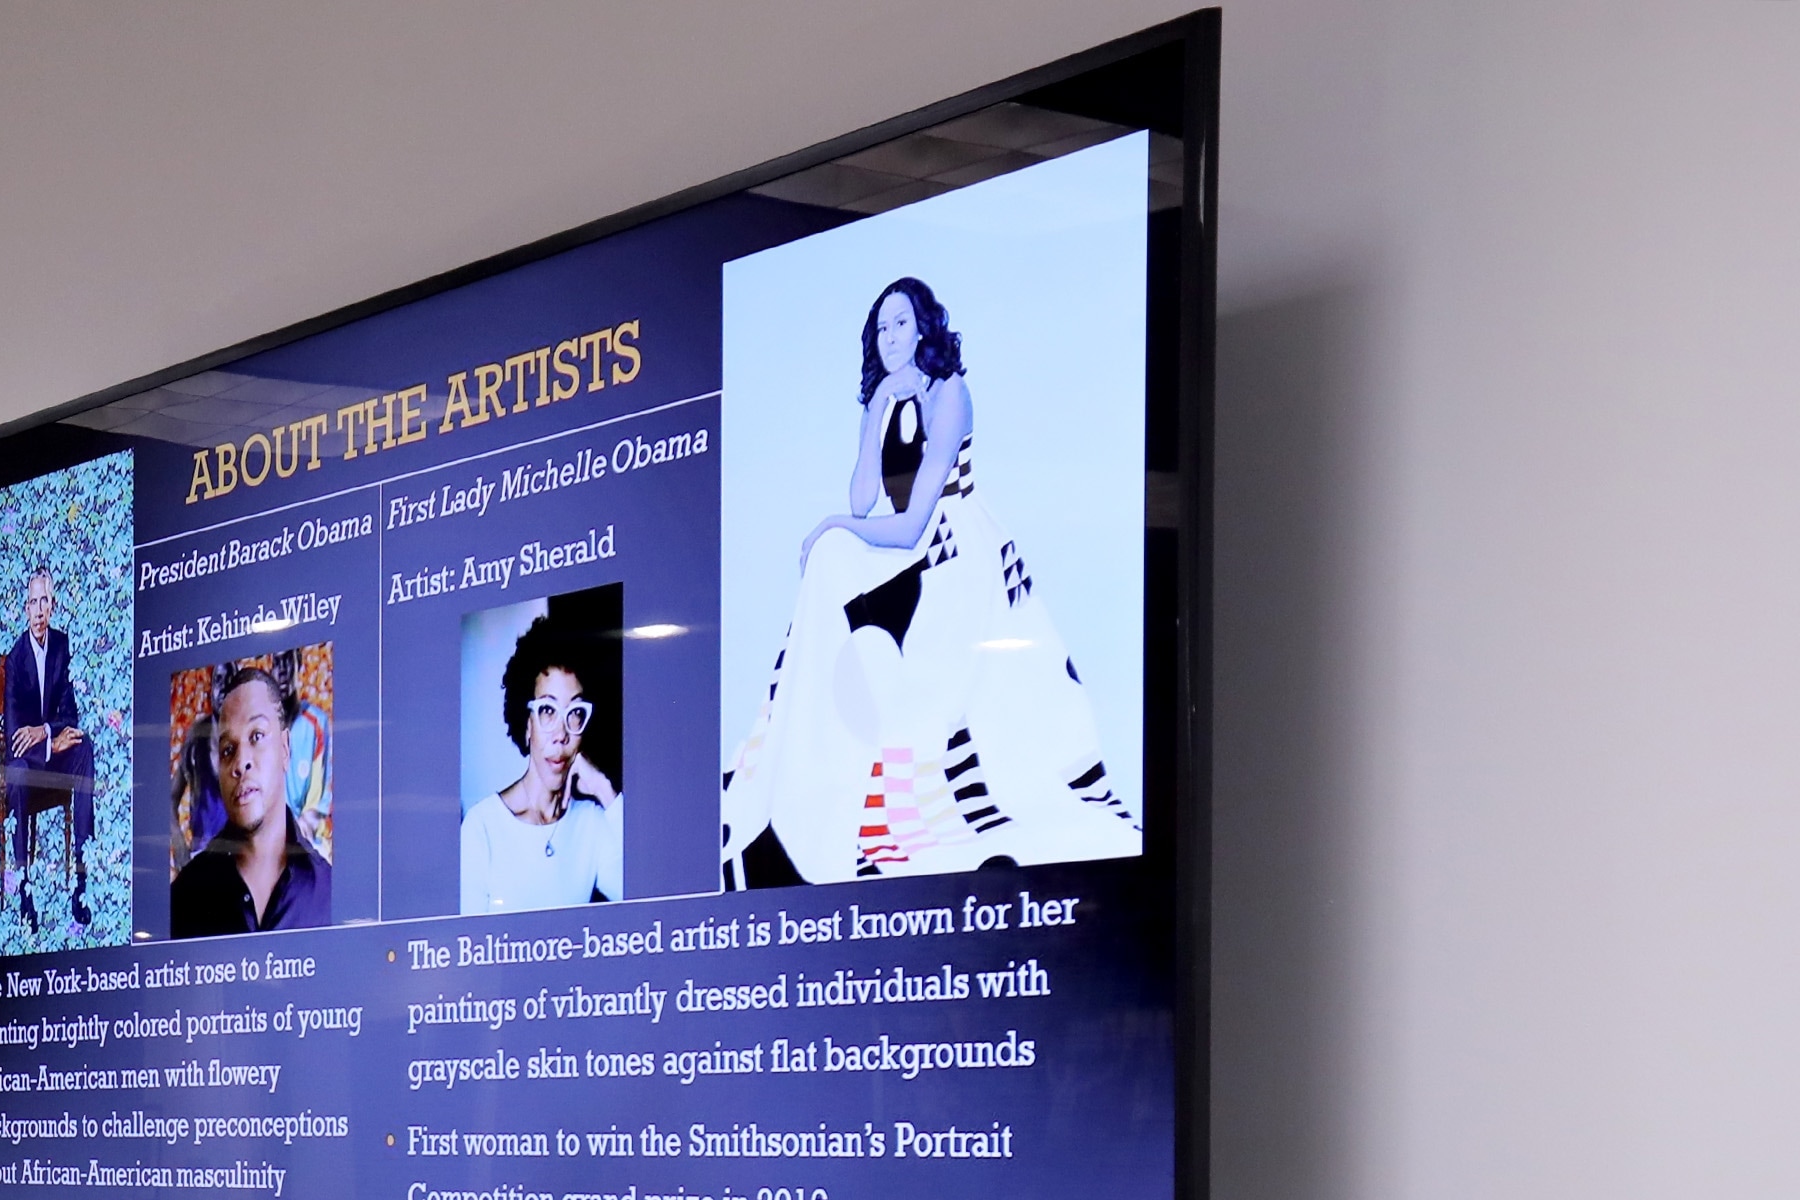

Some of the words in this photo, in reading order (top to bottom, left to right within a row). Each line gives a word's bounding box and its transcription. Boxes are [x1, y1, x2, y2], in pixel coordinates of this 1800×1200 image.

[185, 412, 329, 505] ABOUT
[336, 383, 427, 460] THE
[438, 319, 643, 433] ARTISTS
[386, 485, 437, 531] First
[439, 476, 496, 517] Lady
[499, 448, 607, 503] Michelle
[611, 429, 708, 474] Obama
[138, 544, 229, 593] President
[227, 526, 295, 569] Barack
[297, 514, 373, 551] Obama
[387, 565, 456, 605] Artist:
[458, 556, 516, 590] Amy
[519, 524, 616, 576] Sherald
[138, 624, 194, 658] Artist:
[279, 592, 343, 636] Wiley
[407, 939, 451, 970] The
[456, 920, 664, 967] Baltimore-based
[670, 917, 740, 952] artist
[746, 913, 771, 947] is
[778, 910, 843, 945] best
[849, 904, 955, 940] known
[962, 895, 1012, 932] for
[1019, 891, 1080, 928] her
[6, 972, 42, 998] New
[43, 962, 141, 995] York-based
[144, 959, 191, 988] artist
[194, 962, 237, 985] rose
[240, 957, 260, 982] to
[264, 951, 316, 980] fame
[407, 991, 517, 1034] paintings
[523, 988, 549, 1020] of
[550, 981, 668, 1024] vibrantly
[675, 974, 789, 1012] dressed
[796, 964, 970, 1007] individuals
[976, 959, 1051, 998] with
[41, 1014, 110, 1049] brightly
[113, 1009, 183, 1039] colored
[185, 1007, 268, 1044] portraits
[273, 1003, 294, 1032] of
[297, 1006, 364, 1039] young
[120, 1068, 161, 1089] men
[164, 1059, 206, 1088] with
[207, 1059, 282, 1094] flowery
[407, 1049, 520, 1090] grayscale
[527, 1046, 580, 1079] skin
[585, 1049, 655, 1077] tones
[662, 1040, 764, 1085] against
[770, 1038, 818, 1073] flat
[823, 1030, 1036, 1080] backgrounds
[81, 1114, 98, 1138] to
[102, 1110, 190, 1145] challenge
[193, 1108, 349, 1145] preconceptions
[407, 1126, 459, 1156] First
[462, 1134, 550, 1156] woman
[555, 1128, 581, 1156] to
[585, 1124, 635, 1157] win
[639, 1124, 682, 1157] the
[894, 1121, 1013, 1158] Portrait
[20, 1159, 174, 1187] African-American
[175, 1160, 287, 1197] masculinity
